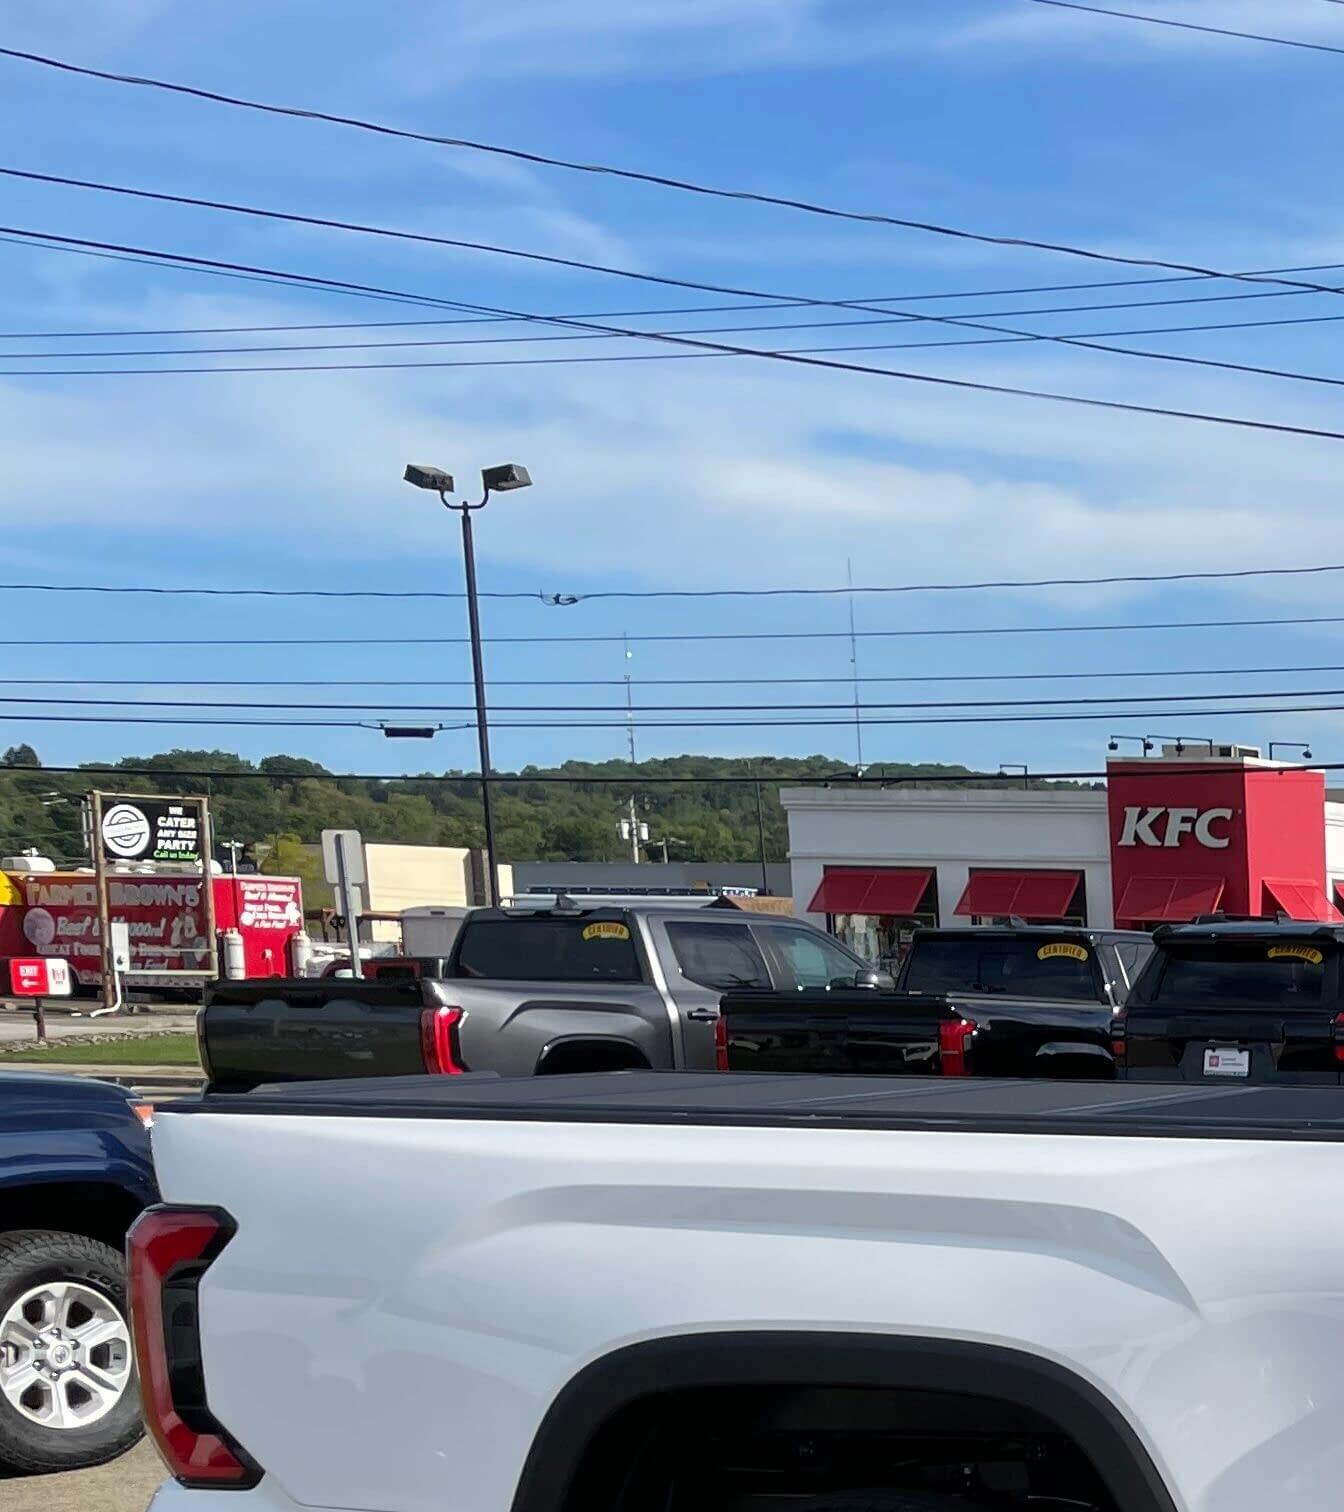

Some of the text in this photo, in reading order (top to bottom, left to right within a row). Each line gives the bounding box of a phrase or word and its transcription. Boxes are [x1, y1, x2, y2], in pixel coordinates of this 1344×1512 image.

[157, 816, 196, 828] CATER
[1117, 806, 1233, 848] KFC
[157, 829, 176, 837] ANY
[157, 839, 196, 851] PARTY
